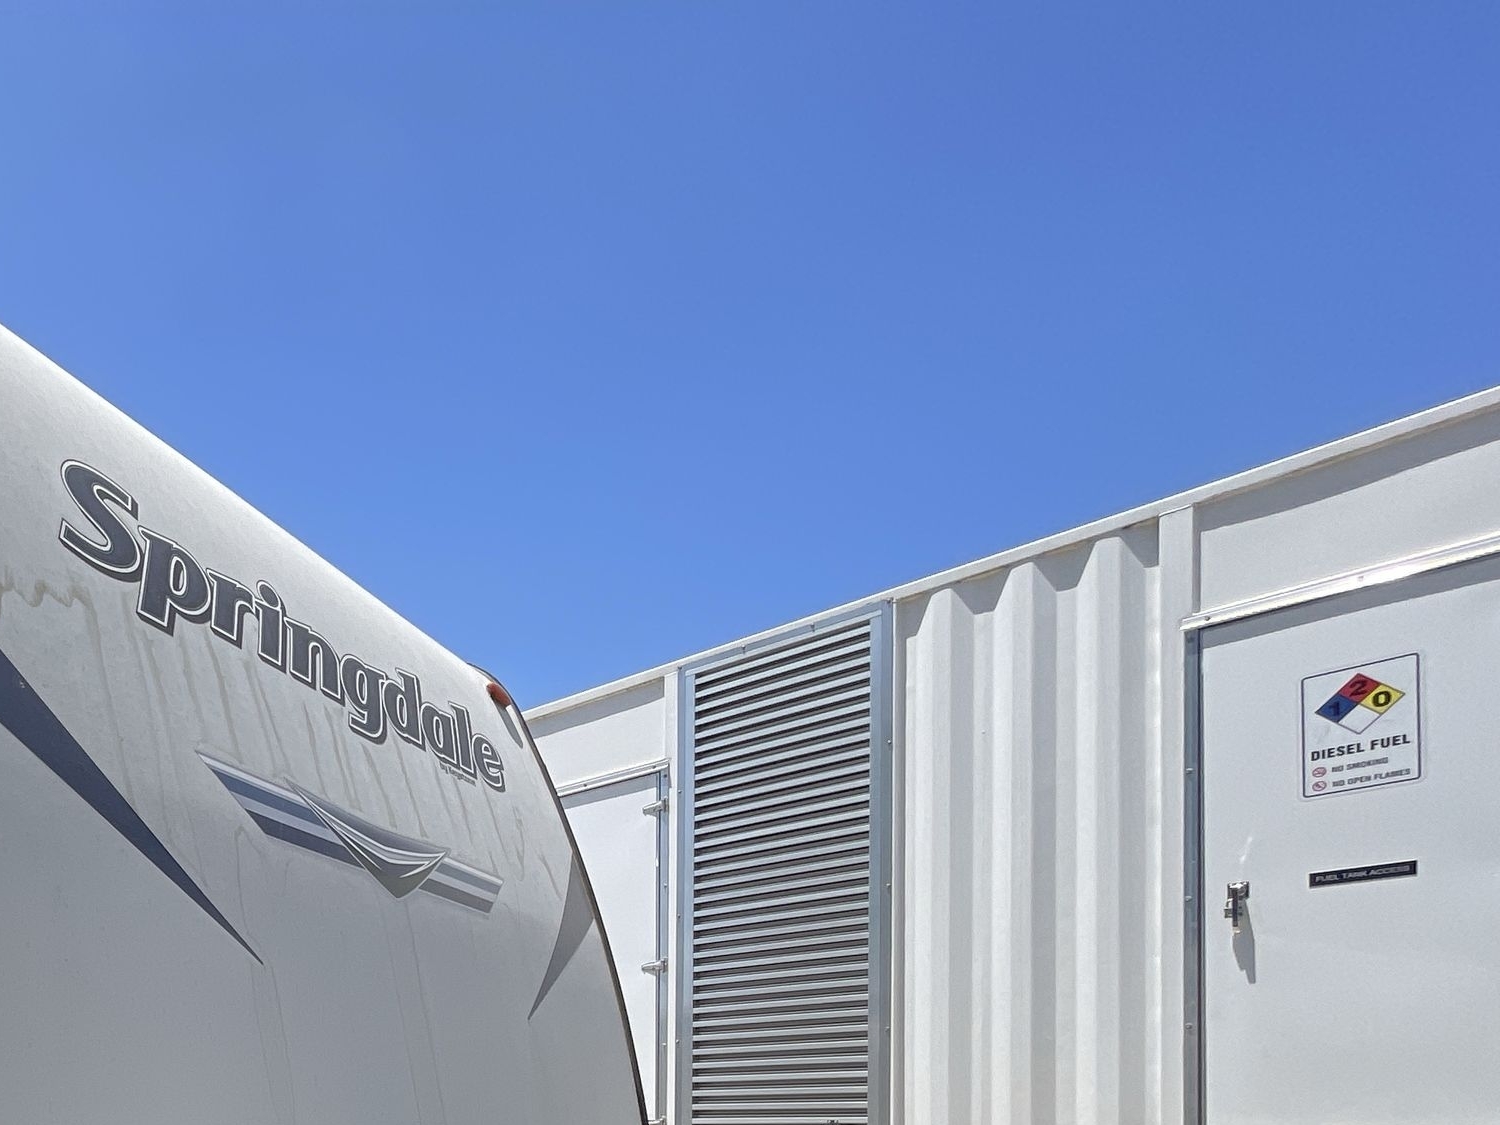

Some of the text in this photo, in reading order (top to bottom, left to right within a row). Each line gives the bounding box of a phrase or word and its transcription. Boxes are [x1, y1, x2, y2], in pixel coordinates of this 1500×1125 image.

[58, 458, 506, 792] Springdale
[1350, 680, 1368, 697] 2
[1372, 690, 1392, 707] 0
[1329, 701, 1340, 716] 1
[1311, 734, 1411, 761] DIESEL FUEL
[1346, 757, 1389, 770] SMOKING
[1347, 776, 1371, 785] OPEN
[1373, 768, 1411, 780] FLAMES
[1315, 865, 1410, 882] FUEL TANK ACCESS
